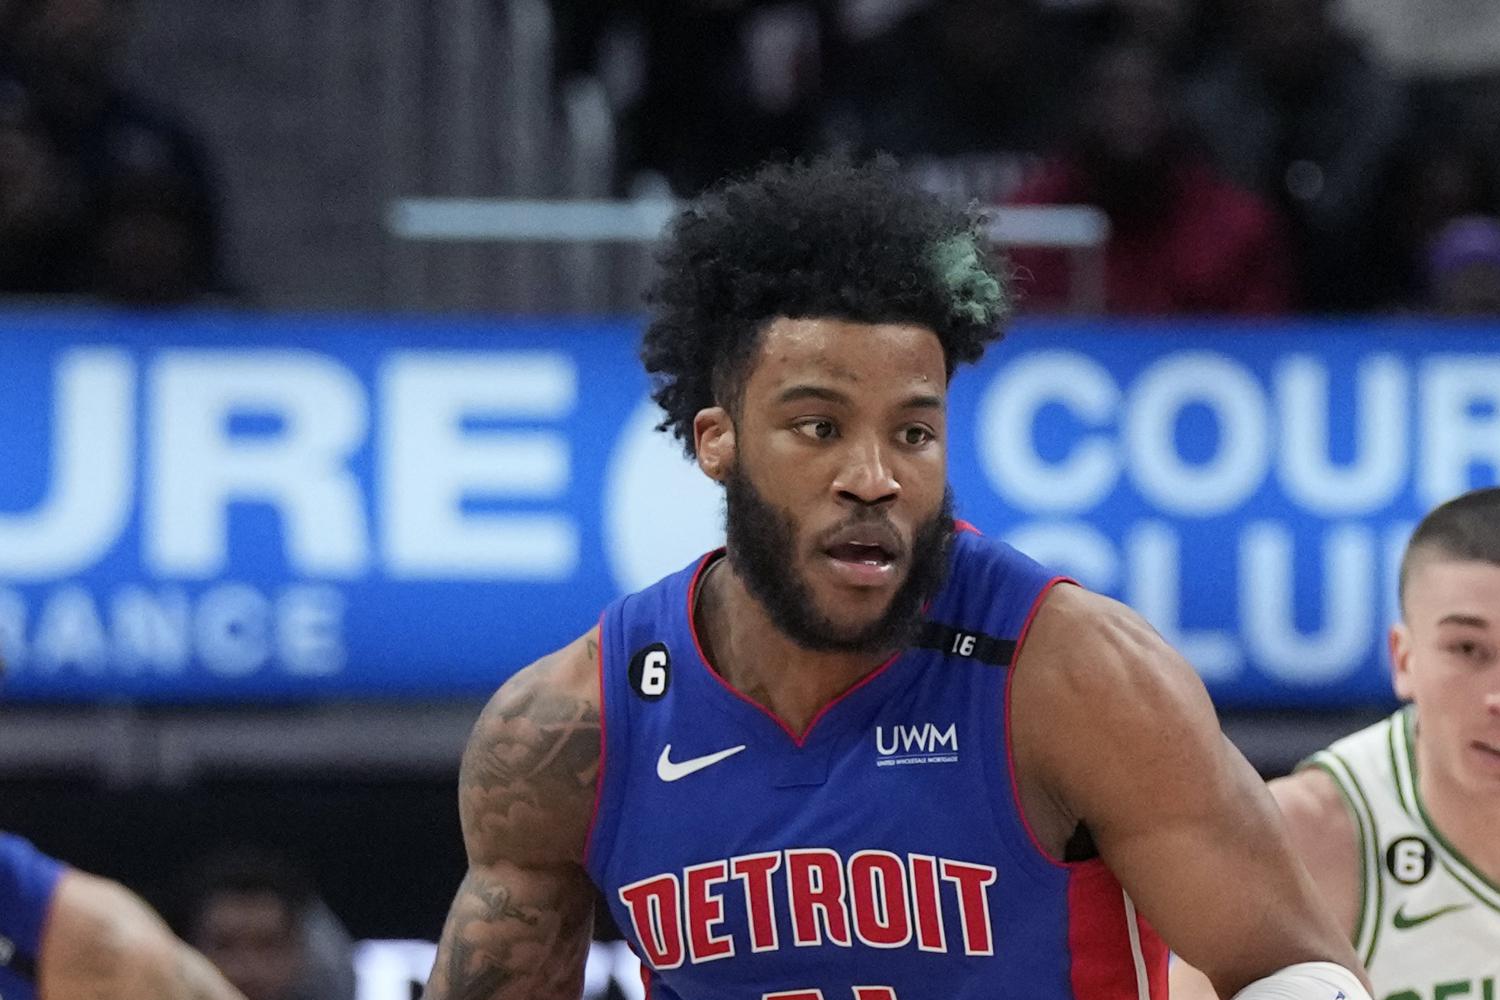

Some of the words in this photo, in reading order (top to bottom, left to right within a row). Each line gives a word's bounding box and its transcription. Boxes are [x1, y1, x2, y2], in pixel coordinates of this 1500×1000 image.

[0, 345, 580, 583] URE
[951, 632, 977, 657] 16
[640, 650, 667, 696] 6
[876, 722, 959, 756] UWM
[1394, 840, 1426, 881] 6
[618, 848, 997, 970] DETROIT
